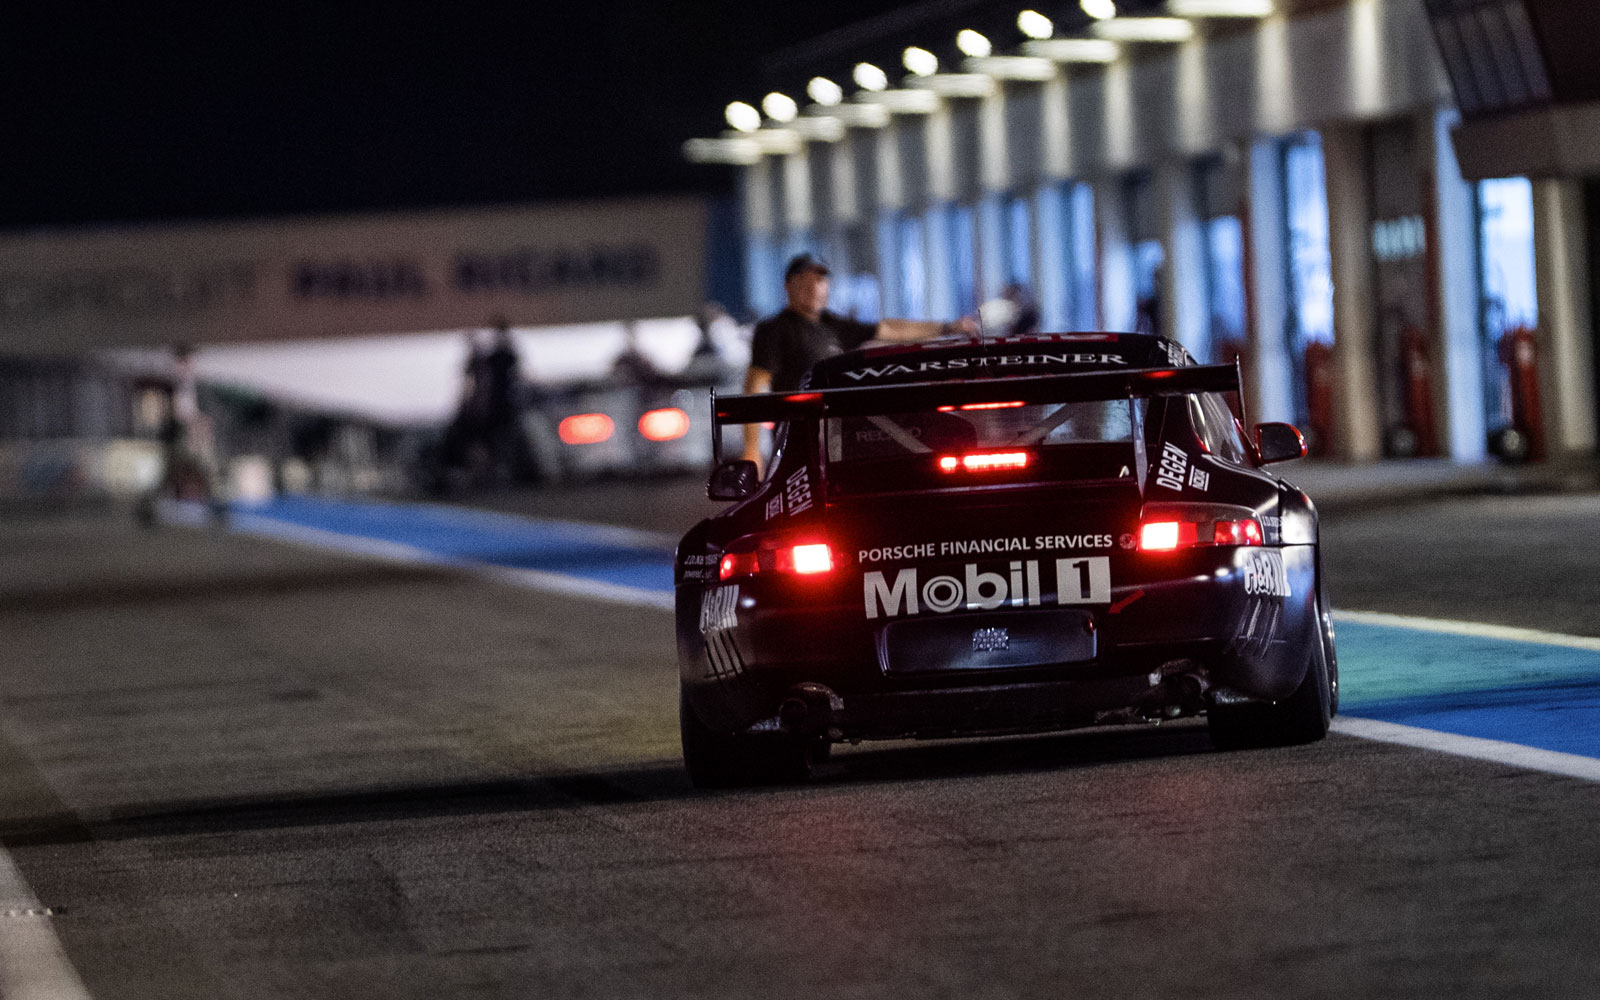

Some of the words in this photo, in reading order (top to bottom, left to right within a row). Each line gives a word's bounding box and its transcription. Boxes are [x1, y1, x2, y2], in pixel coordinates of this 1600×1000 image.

[844, 353, 1128, 381] WARSTEINER
[855, 427, 922, 442] RECO
[1156, 441, 1188, 492] DEGEN
[786, 465, 813, 517] DEGEN
[858, 543, 936, 563] PORSCHE
[940, 537, 1031, 556] FINANCIAL
[1035, 534, 1114, 550] SERVICES
[863, 560, 1041, 620] Mobil
